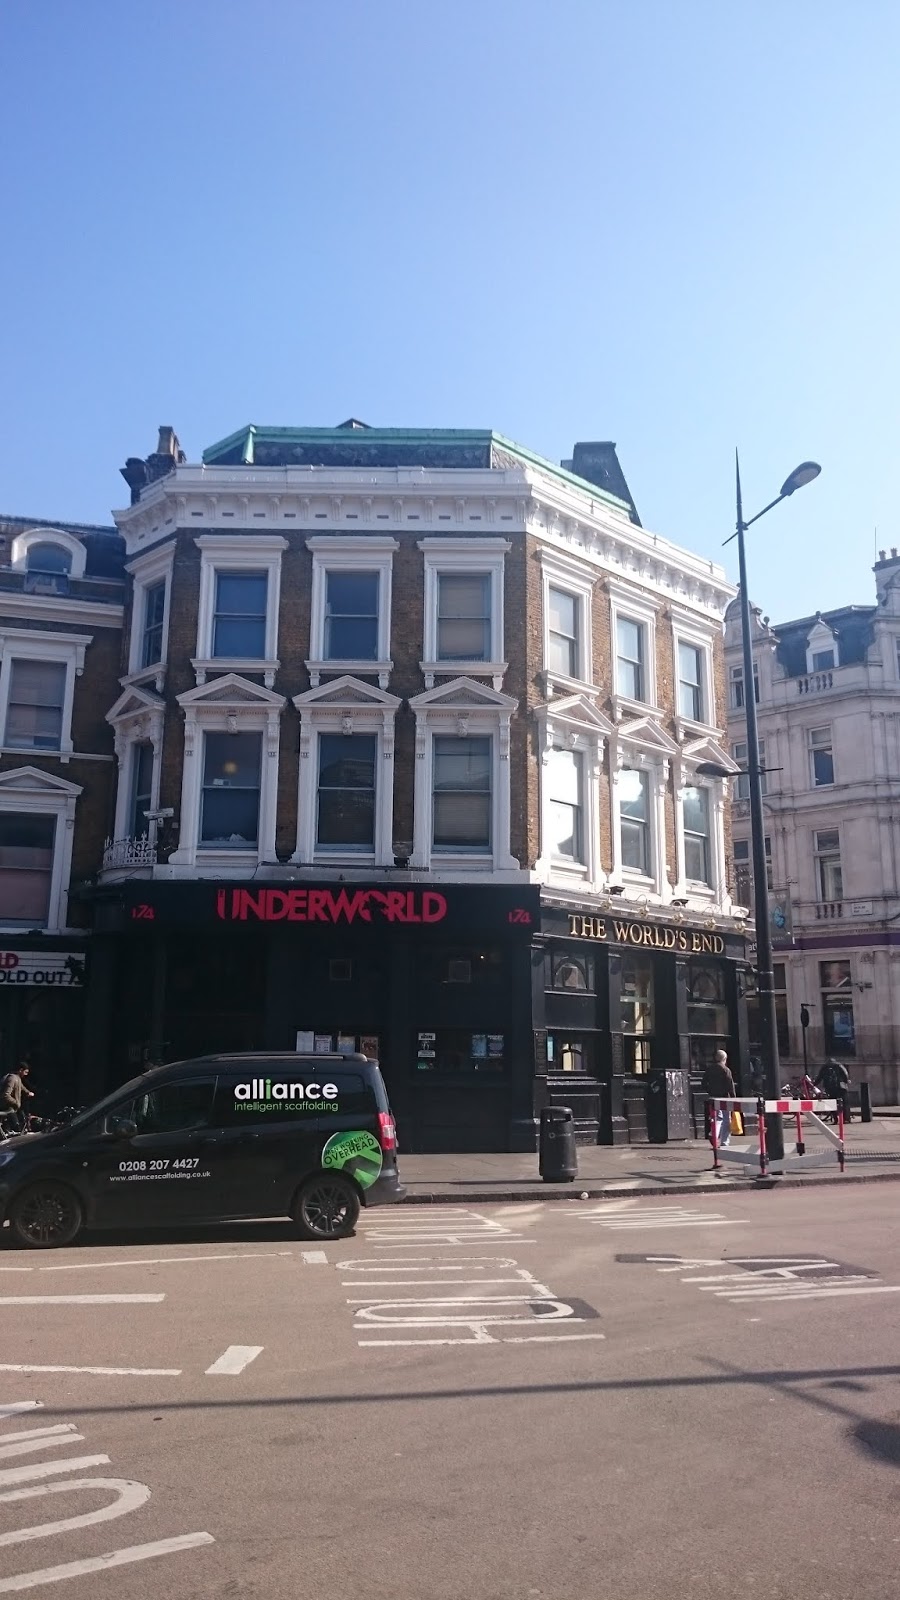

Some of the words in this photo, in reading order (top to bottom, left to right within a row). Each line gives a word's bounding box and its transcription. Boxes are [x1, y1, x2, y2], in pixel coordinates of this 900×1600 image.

[216, 887, 447, 925] UNDERWORLD
[509, 909, 531, 923] 174
[567, 914, 607, 939] THE
[612, 920, 687, 950] WORLD'S
[691, 932, 724, 954] END
[33, 970, 66, 984] OUT
[234, 1078, 339, 1100] alliance
[234, 1101, 282, 1112] intelligent
[284, 1101, 339, 1112] scaffolding
[340, 1133, 369, 1149] WORKING
[324, 1137, 375, 1165] OVERHEAD
[119, 1160, 147, 1172] 0208
[149, 1159, 170, 1171] 207
[172, 1158, 200, 1170] 4427
[109, 1171, 211, 1181] www.alliancescaffolding.co.uk
